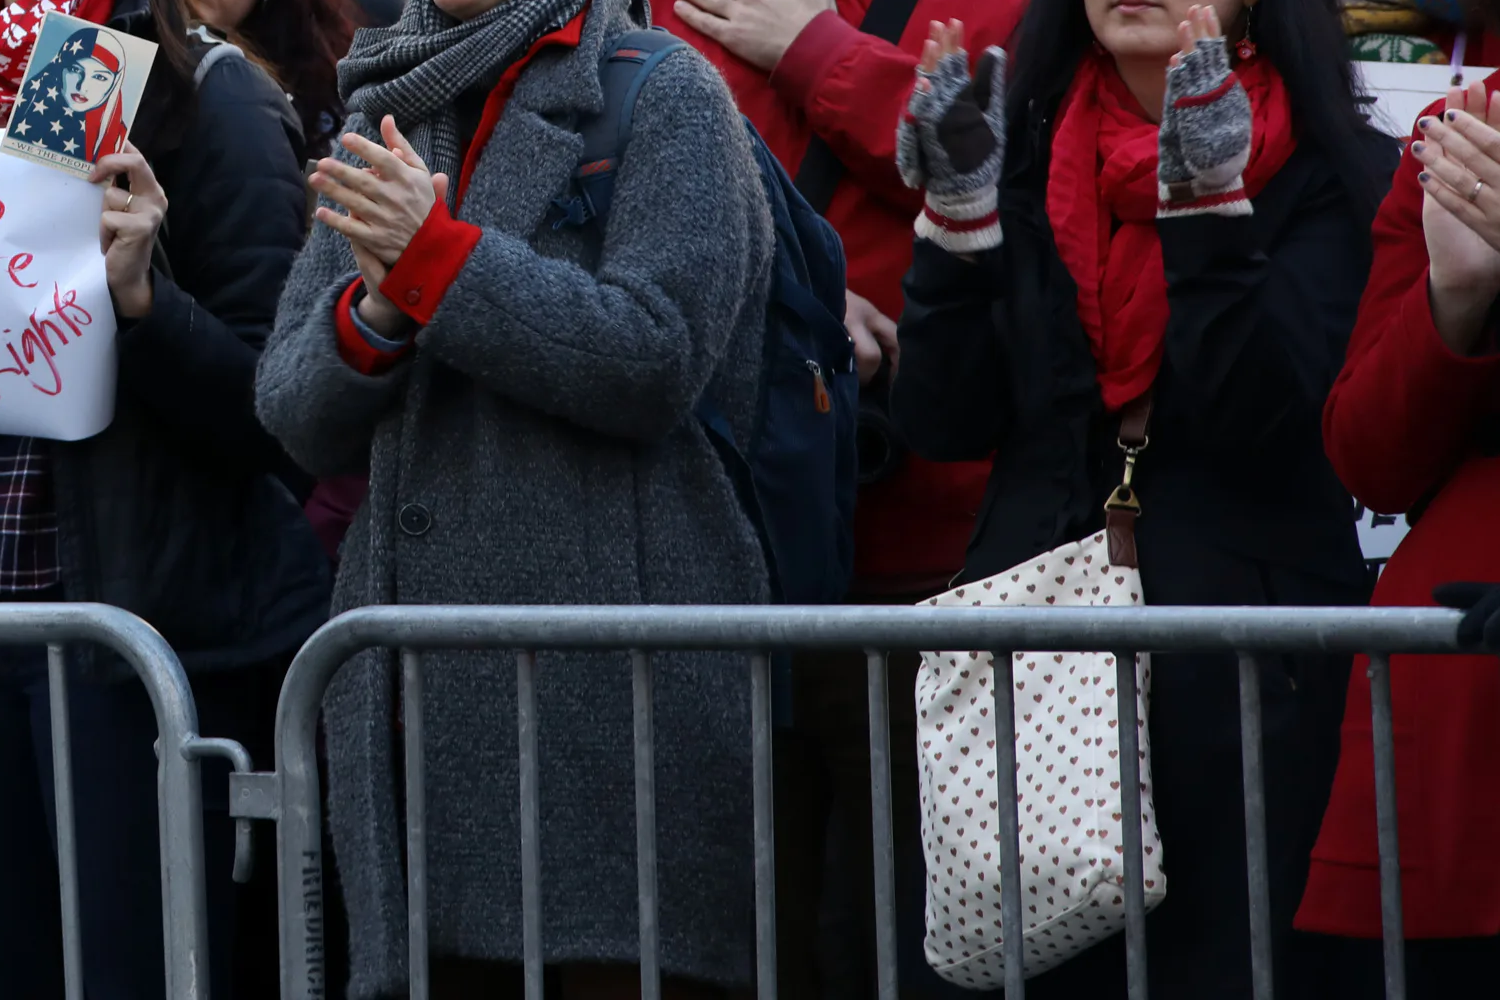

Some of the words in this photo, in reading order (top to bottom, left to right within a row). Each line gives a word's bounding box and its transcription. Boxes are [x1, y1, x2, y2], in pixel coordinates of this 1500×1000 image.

[16, 142, 34, 153] WE
[37, 147, 58, 160] THE
[60, 155, 92, 172] PEOPL
